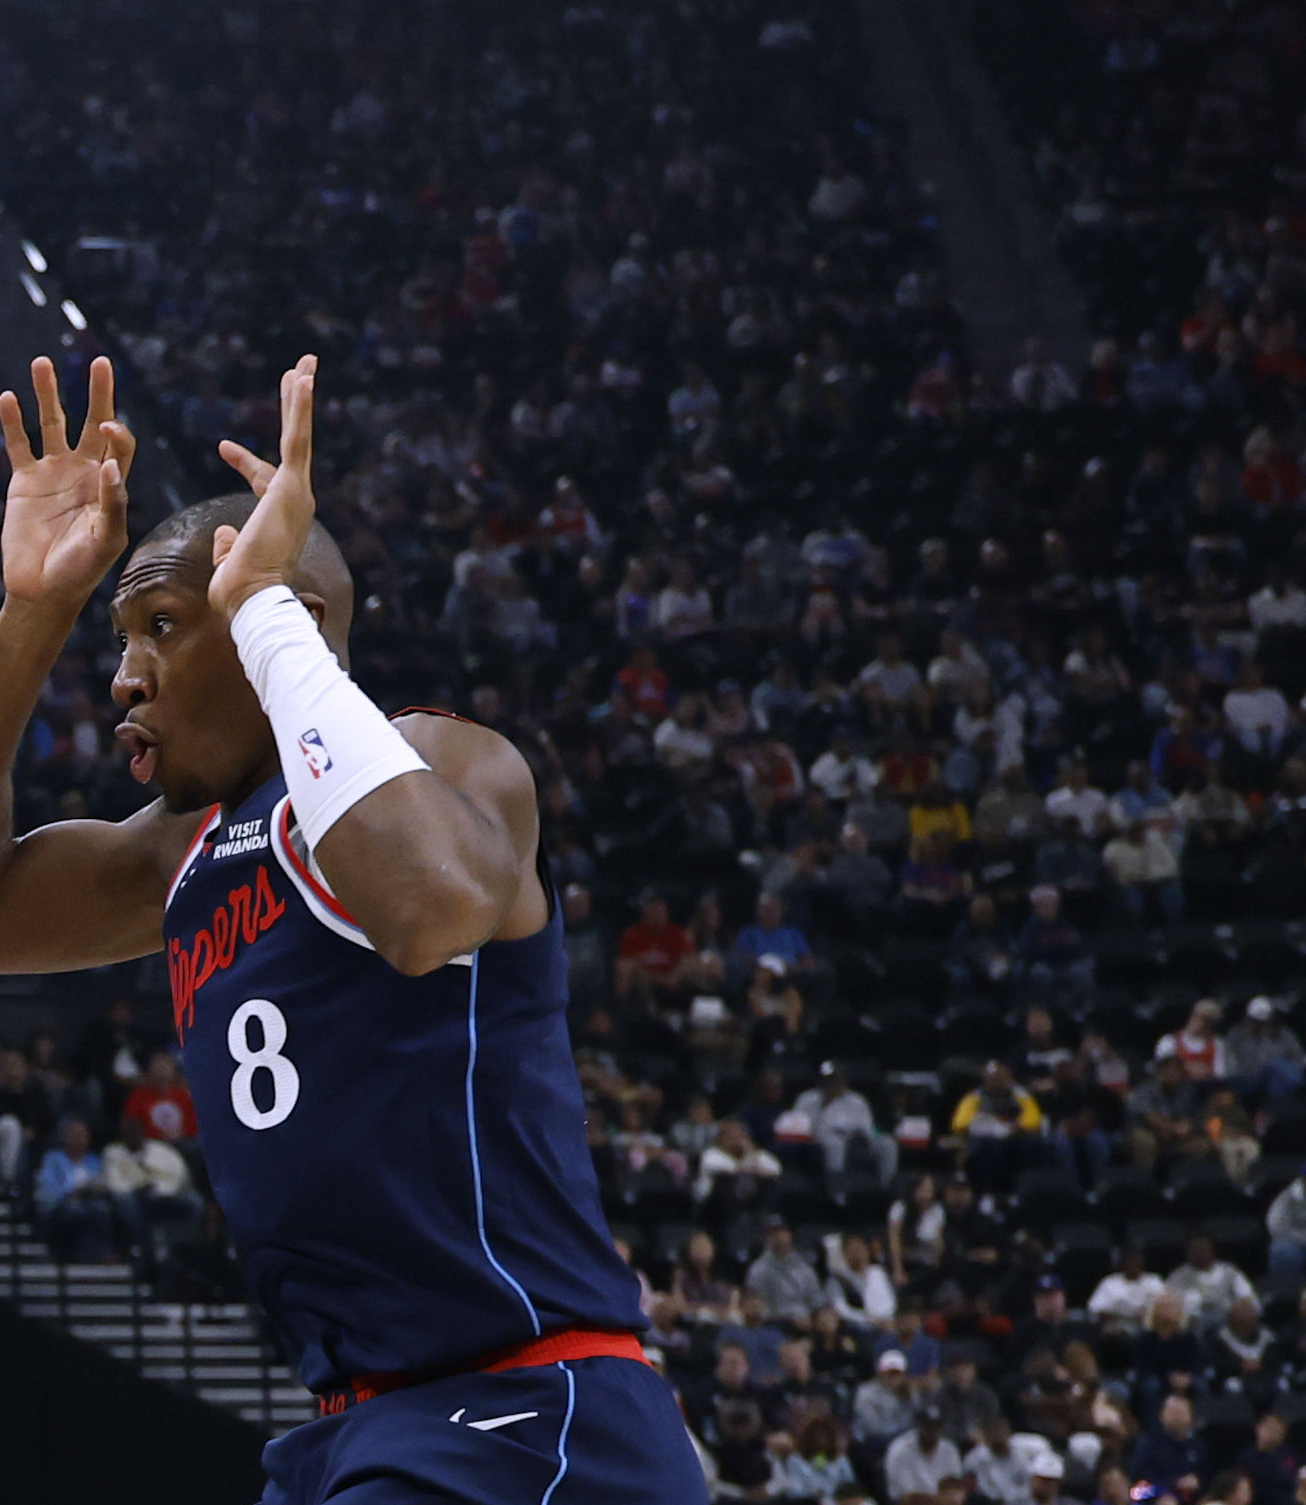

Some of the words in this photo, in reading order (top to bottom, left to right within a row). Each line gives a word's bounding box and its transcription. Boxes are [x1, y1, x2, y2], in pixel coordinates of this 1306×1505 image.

[228, 819, 264, 841] VISIT
[212, 832, 269, 861] RWANDA
[227, 998, 300, 1131] 8
